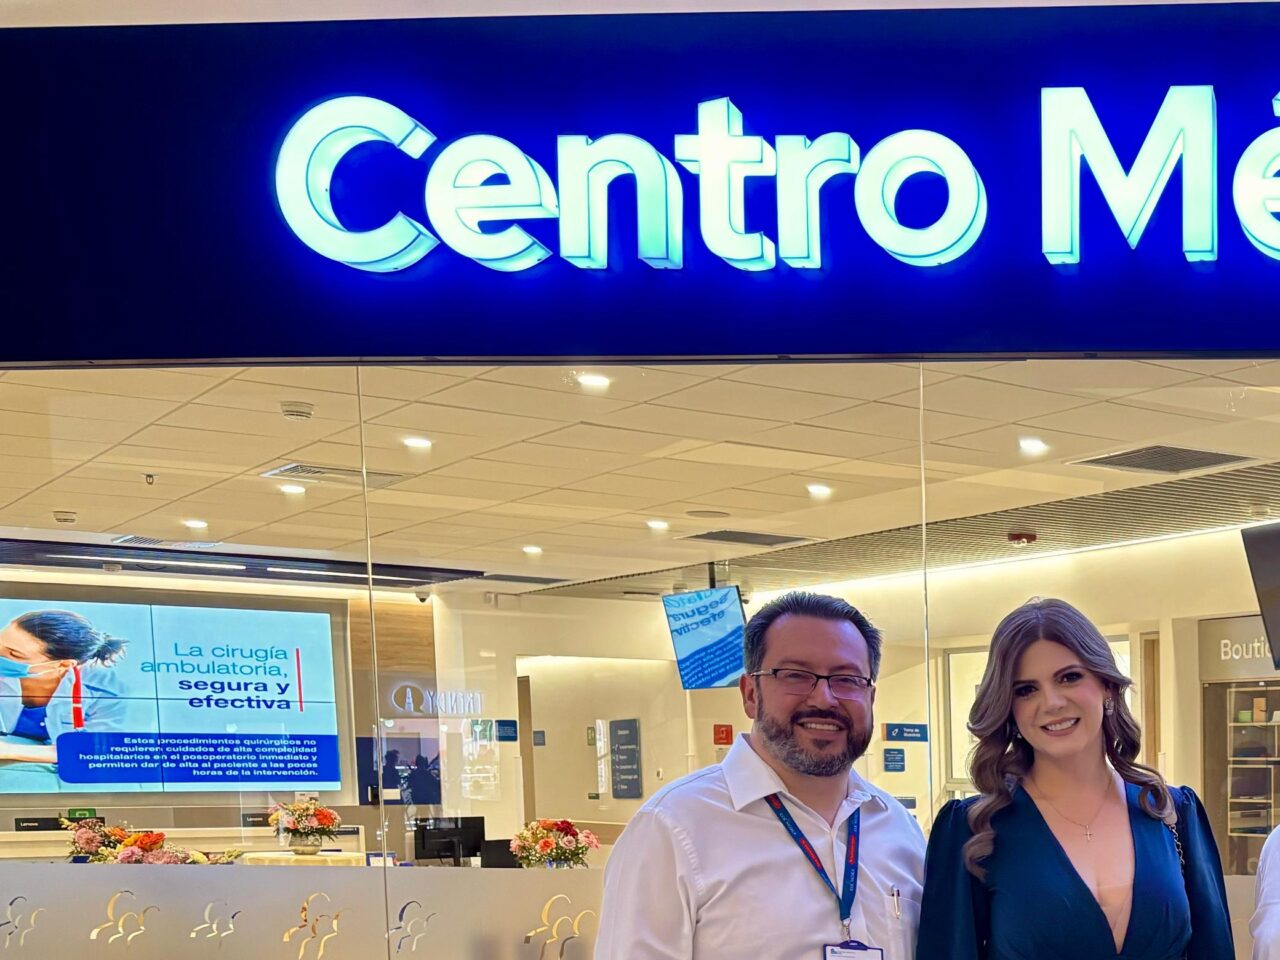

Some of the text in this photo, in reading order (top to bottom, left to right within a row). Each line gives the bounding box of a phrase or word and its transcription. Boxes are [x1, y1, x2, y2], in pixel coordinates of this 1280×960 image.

[275, 95, 988, 272] Centro
[174, 642, 288, 662] La cirugía
[140, 660, 288, 678] ambulatoria,
[178, 679, 290, 695] segura y
[188, 695, 291, 710] efectiva
[157, 738, 241, 746] procedimientos
[243, 738, 301, 746] quirúrgicos
[255, 746, 317, 754] complejidad
